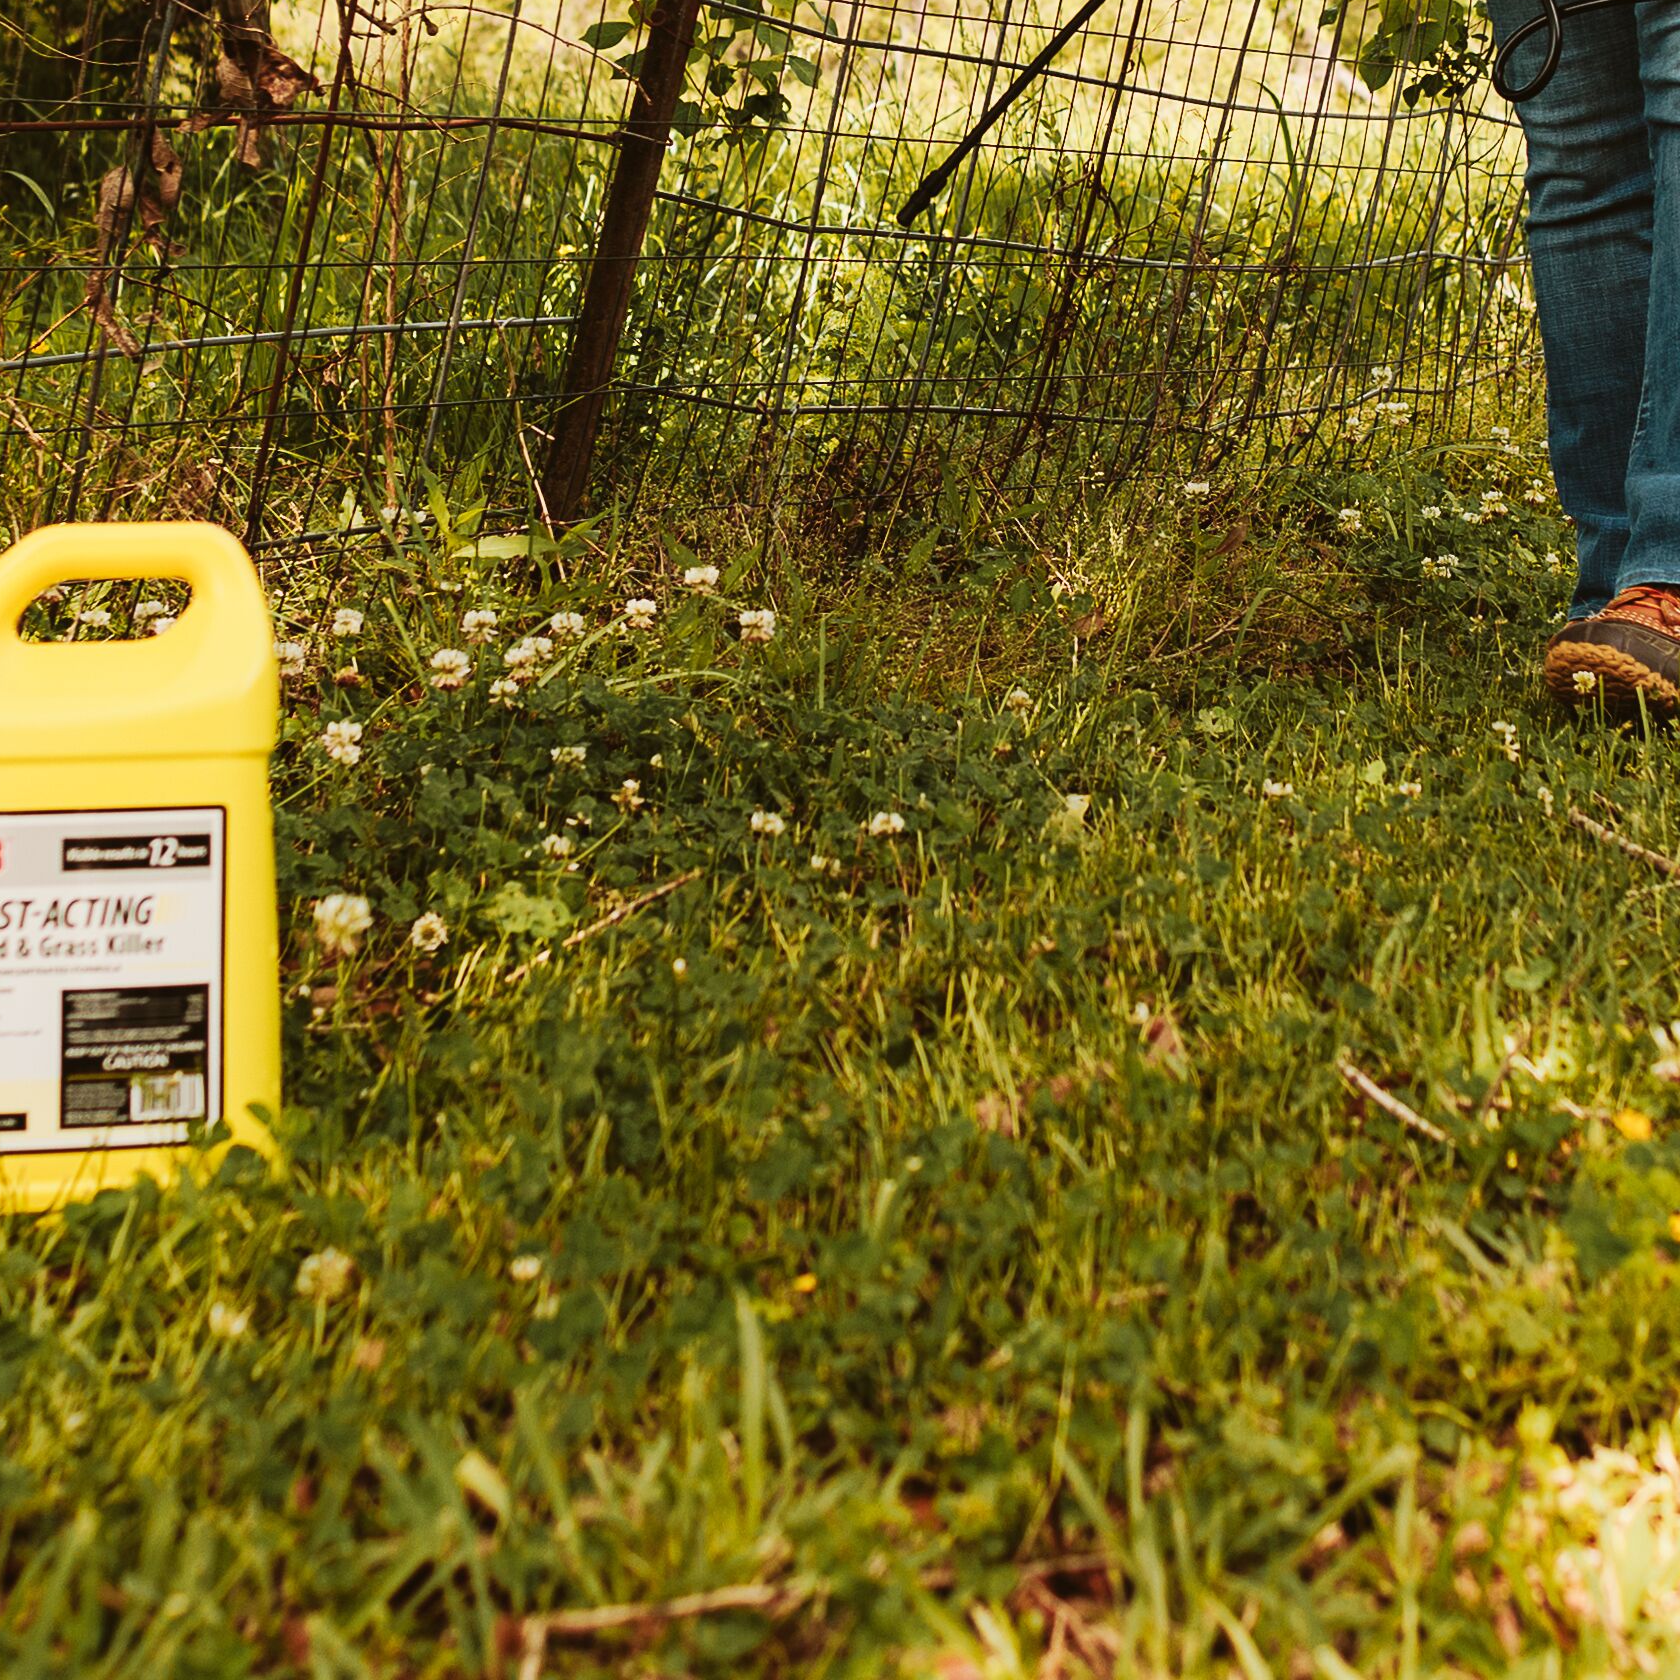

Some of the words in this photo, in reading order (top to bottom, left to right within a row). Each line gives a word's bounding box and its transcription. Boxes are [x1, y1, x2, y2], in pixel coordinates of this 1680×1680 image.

[149, 836, 179, 867] 12
[15, 937, 31, 957] &
[39, 935, 98, 957] Grass
[107, 932, 165, 954] Killer
